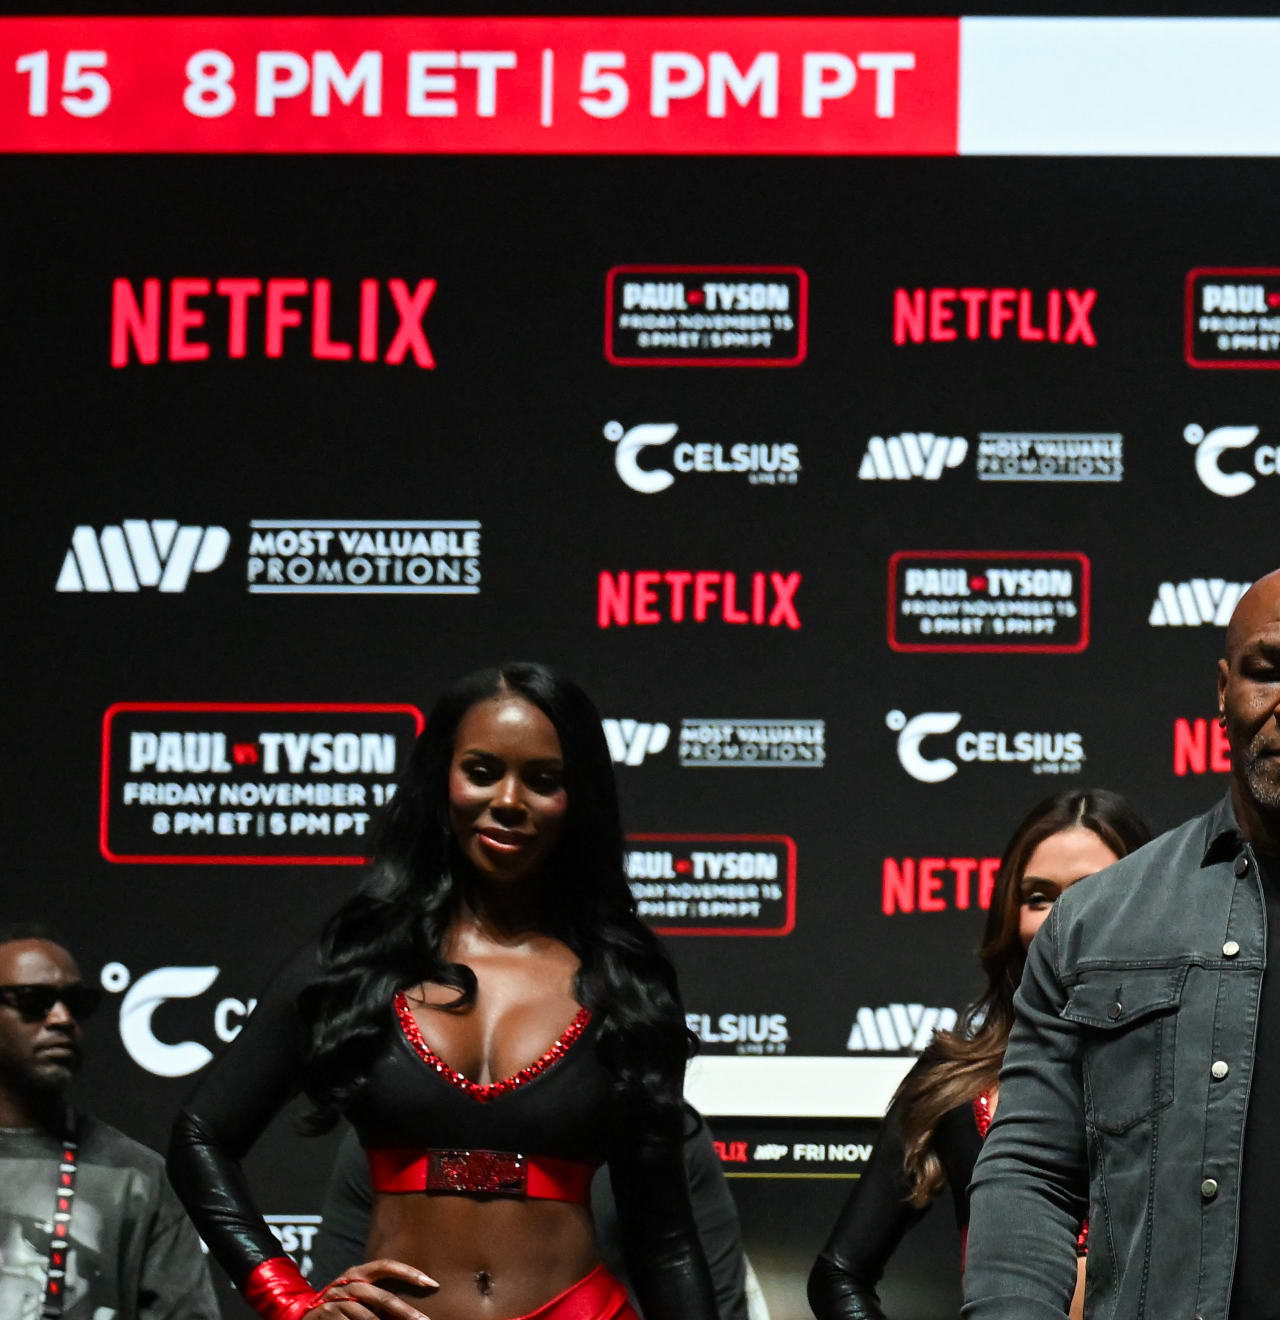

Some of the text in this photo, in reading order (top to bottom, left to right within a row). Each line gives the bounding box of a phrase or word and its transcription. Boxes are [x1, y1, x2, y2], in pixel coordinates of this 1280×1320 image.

[16, 50, 915, 118] 15 8 PM ET 5 PM PT
[624, 283, 789, 310] PAUL TYSON
[1203, 286, 1267, 312] PAUL
[112, 279, 435, 367] NETFLIX
[895, 290, 1095, 344] NETFLIX
[674, 442, 798, 471] CELSIUS
[248, 531, 481, 558] MOST VALUABLE
[248, 557, 482, 585] PROMOTIONS
[906, 569, 1072, 596] PAUL TYSON
[599, 572, 800, 627] NETFLIX
[1149, 579, 1250, 625] MV
[129, 731, 232, 773] PAUL
[259, 732, 396, 774] TYSON
[602, 719, 670, 765] VP
[956, 732, 1083, 762] CELSIUS
[123, 782, 216, 806] FRIDAY
[219, 782, 367, 807] NOVEMBER
[152, 812, 370, 835] 8 PM ET 5 PM PT
[627, 852, 777, 879] AUL TYSON
[793, 1144, 825, 1161] FRI
[828, 1144, 873, 1162] NOV
